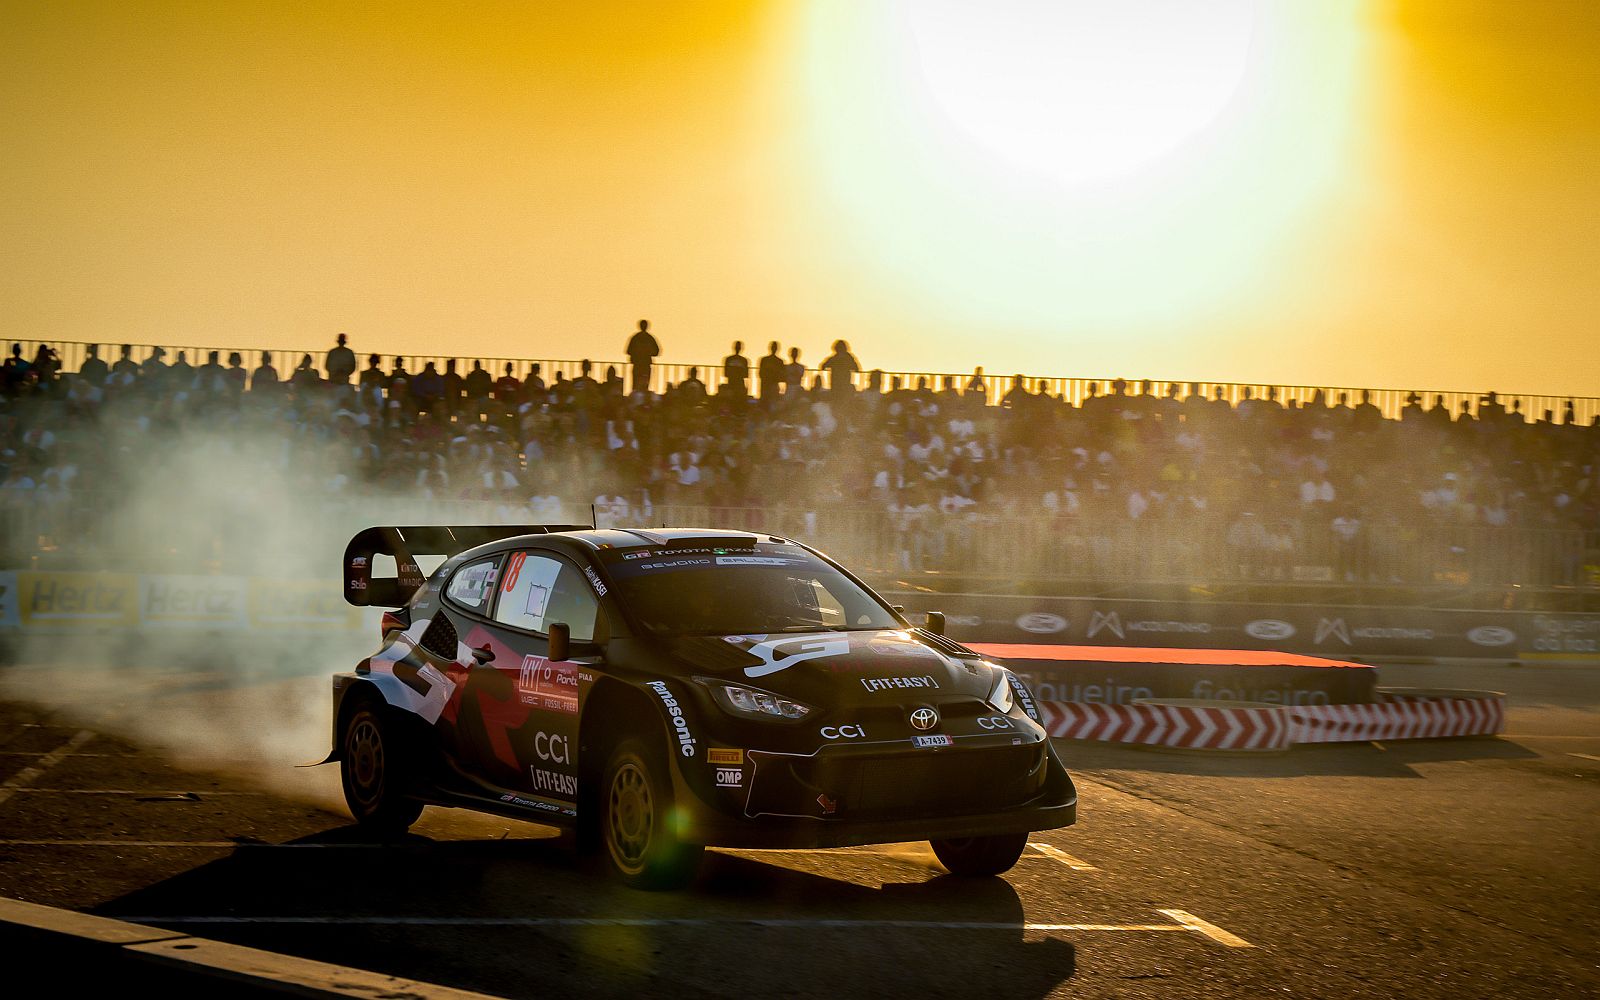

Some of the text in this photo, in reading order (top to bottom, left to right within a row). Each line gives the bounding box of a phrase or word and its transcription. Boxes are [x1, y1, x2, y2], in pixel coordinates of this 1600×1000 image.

[623, 551, 651, 560] GR
[654, 548, 711, 556] TOYOTA
[640, 559, 711, 569] BEYOND
[500, 551, 527, 593] 18
[32, 580, 127, 611] Hertz
[145, 582, 236, 614] Hertz
[579, 672, 593, 682] PIAA
[545, 698, 576, 712] FOSSIL-FREE
[646, 680, 696, 757] Panasonic
[920, 736, 947, 746] A-7439
[716, 771, 743, 784] OMP
